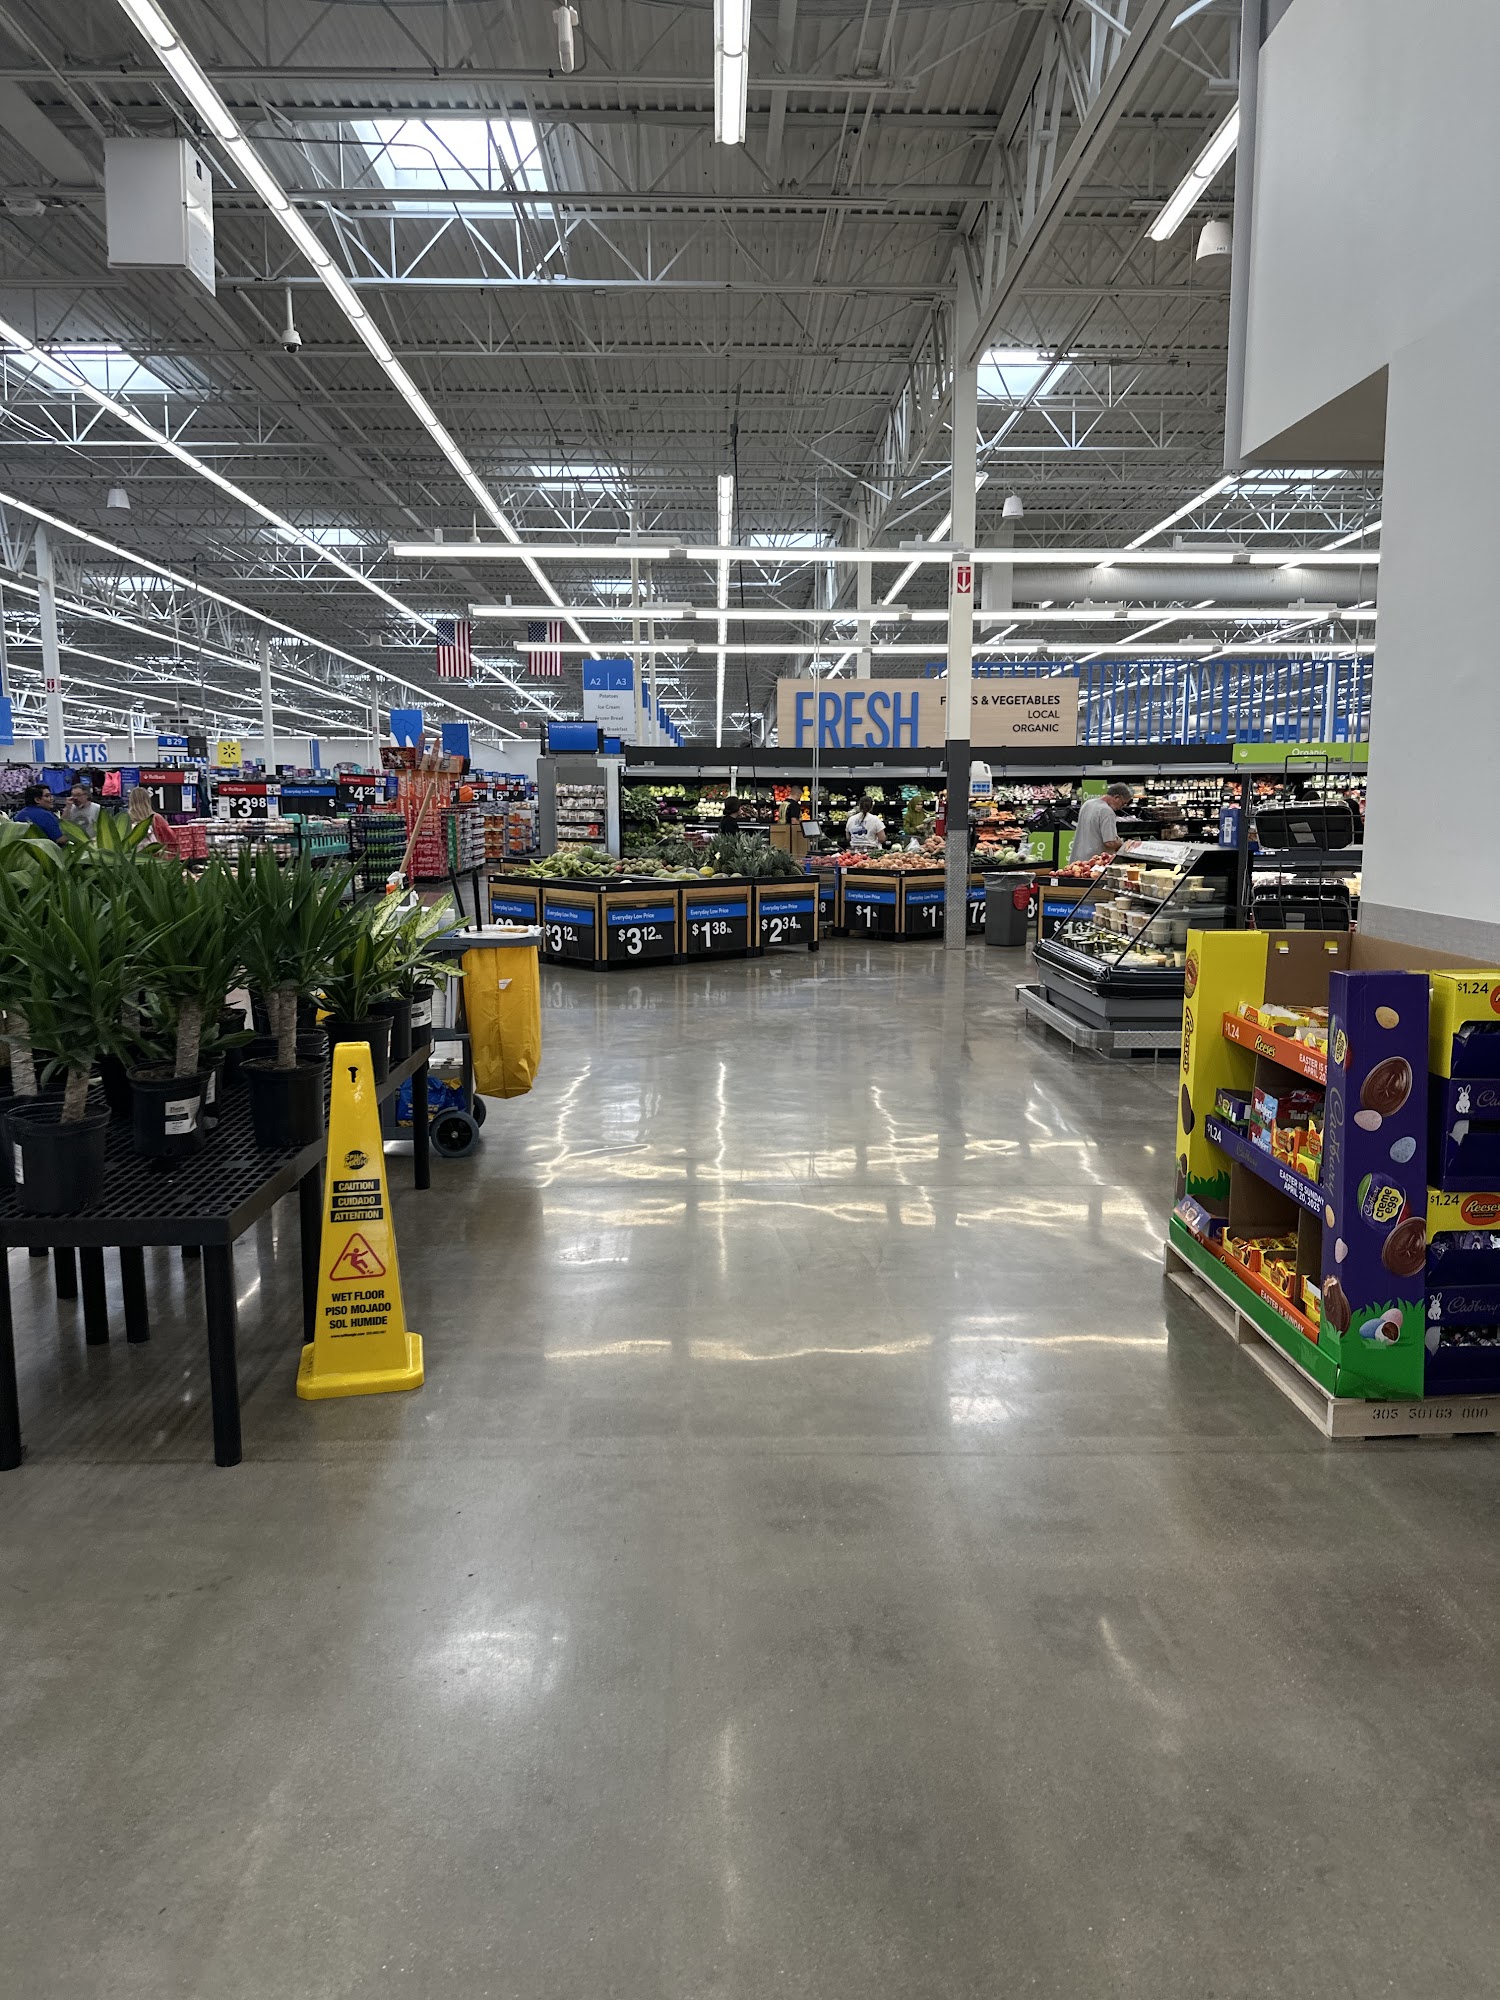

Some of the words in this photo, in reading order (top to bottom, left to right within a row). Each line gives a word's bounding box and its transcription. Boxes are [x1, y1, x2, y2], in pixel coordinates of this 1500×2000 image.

[590, 678, 601, 686] A2
[616, 678, 627, 686] A3
[981, 696, 989, 705] &
[992, 696, 1060, 705] VEGETABLES
[795, 691, 919, 748] FRESH
[1028, 710, 1060, 719] LOCAL
[1012, 724, 1059, 733] ORGANIC
[64, 744, 108, 762] RAFTS
[229, 797, 266, 818] $398
[848, 892, 864, 900] Everyday
[493, 903, 508, 912] Everyday
[690, 908, 709, 917] Everyday
[762, 904, 780, 912] Everyday
[1047, 905, 1067, 914] Everyday
[547, 909, 562, 919] Everyday
[612, 914, 633, 922] Everyday
[1457, 982, 1489, 994] $1.24
[1225, 1021, 1240, 1040] $1.24
[1254, 1034, 1276, 1058] Reese's
[1299, 1053, 1318, 1069] EASTER
[1318, 1061, 1324, 1071] IS
[1303, 1065, 1319, 1079] APRIL
[1207, 1122, 1222, 1144] $1.24
[1325, 1086, 1345, 1197] Cadbury
[338, 1181, 374, 1191] CAUTION
[1279, 1169, 1298, 1188] EASTER
[1298, 1181, 1304, 1191] IS
[1304, 1186, 1325, 1206] SUNDAY
[338, 1196, 375, 1206] CUIDADO
[1283, 1182, 1298, 1198] APRIL
[1298, 1191, 1307, 1205] 20,
[1307, 1197, 1321, 1213] 2025
[1364, 1185, 1381, 1217] Cadbury
[1376, 1188, 1392, 1218] creme
[1430, 1194, 1459, 1206] $1.24
[1385, 1196, 1399, 1214] egg
[334, 1210, 379, 1221] ATTENTION
[331, 1292, 352, 1302] WET
[354, 1290, 385, 1300] FLOOR
[325, 1306, 347, 1316] PISO
[350, 1302, 391, 1314] MOJADO
[1260, 1289, 1279, 1310] EASTER
[1278, 1305, 1284, 1316] IS
[1284, 1311, 1304, 1333] SUNDAY
[1447, 1296, 1500, 1315] Cadbury
[329, 1319, 348, 1329] SOL
[350, 1316, 388, 1328] HUMIDE
